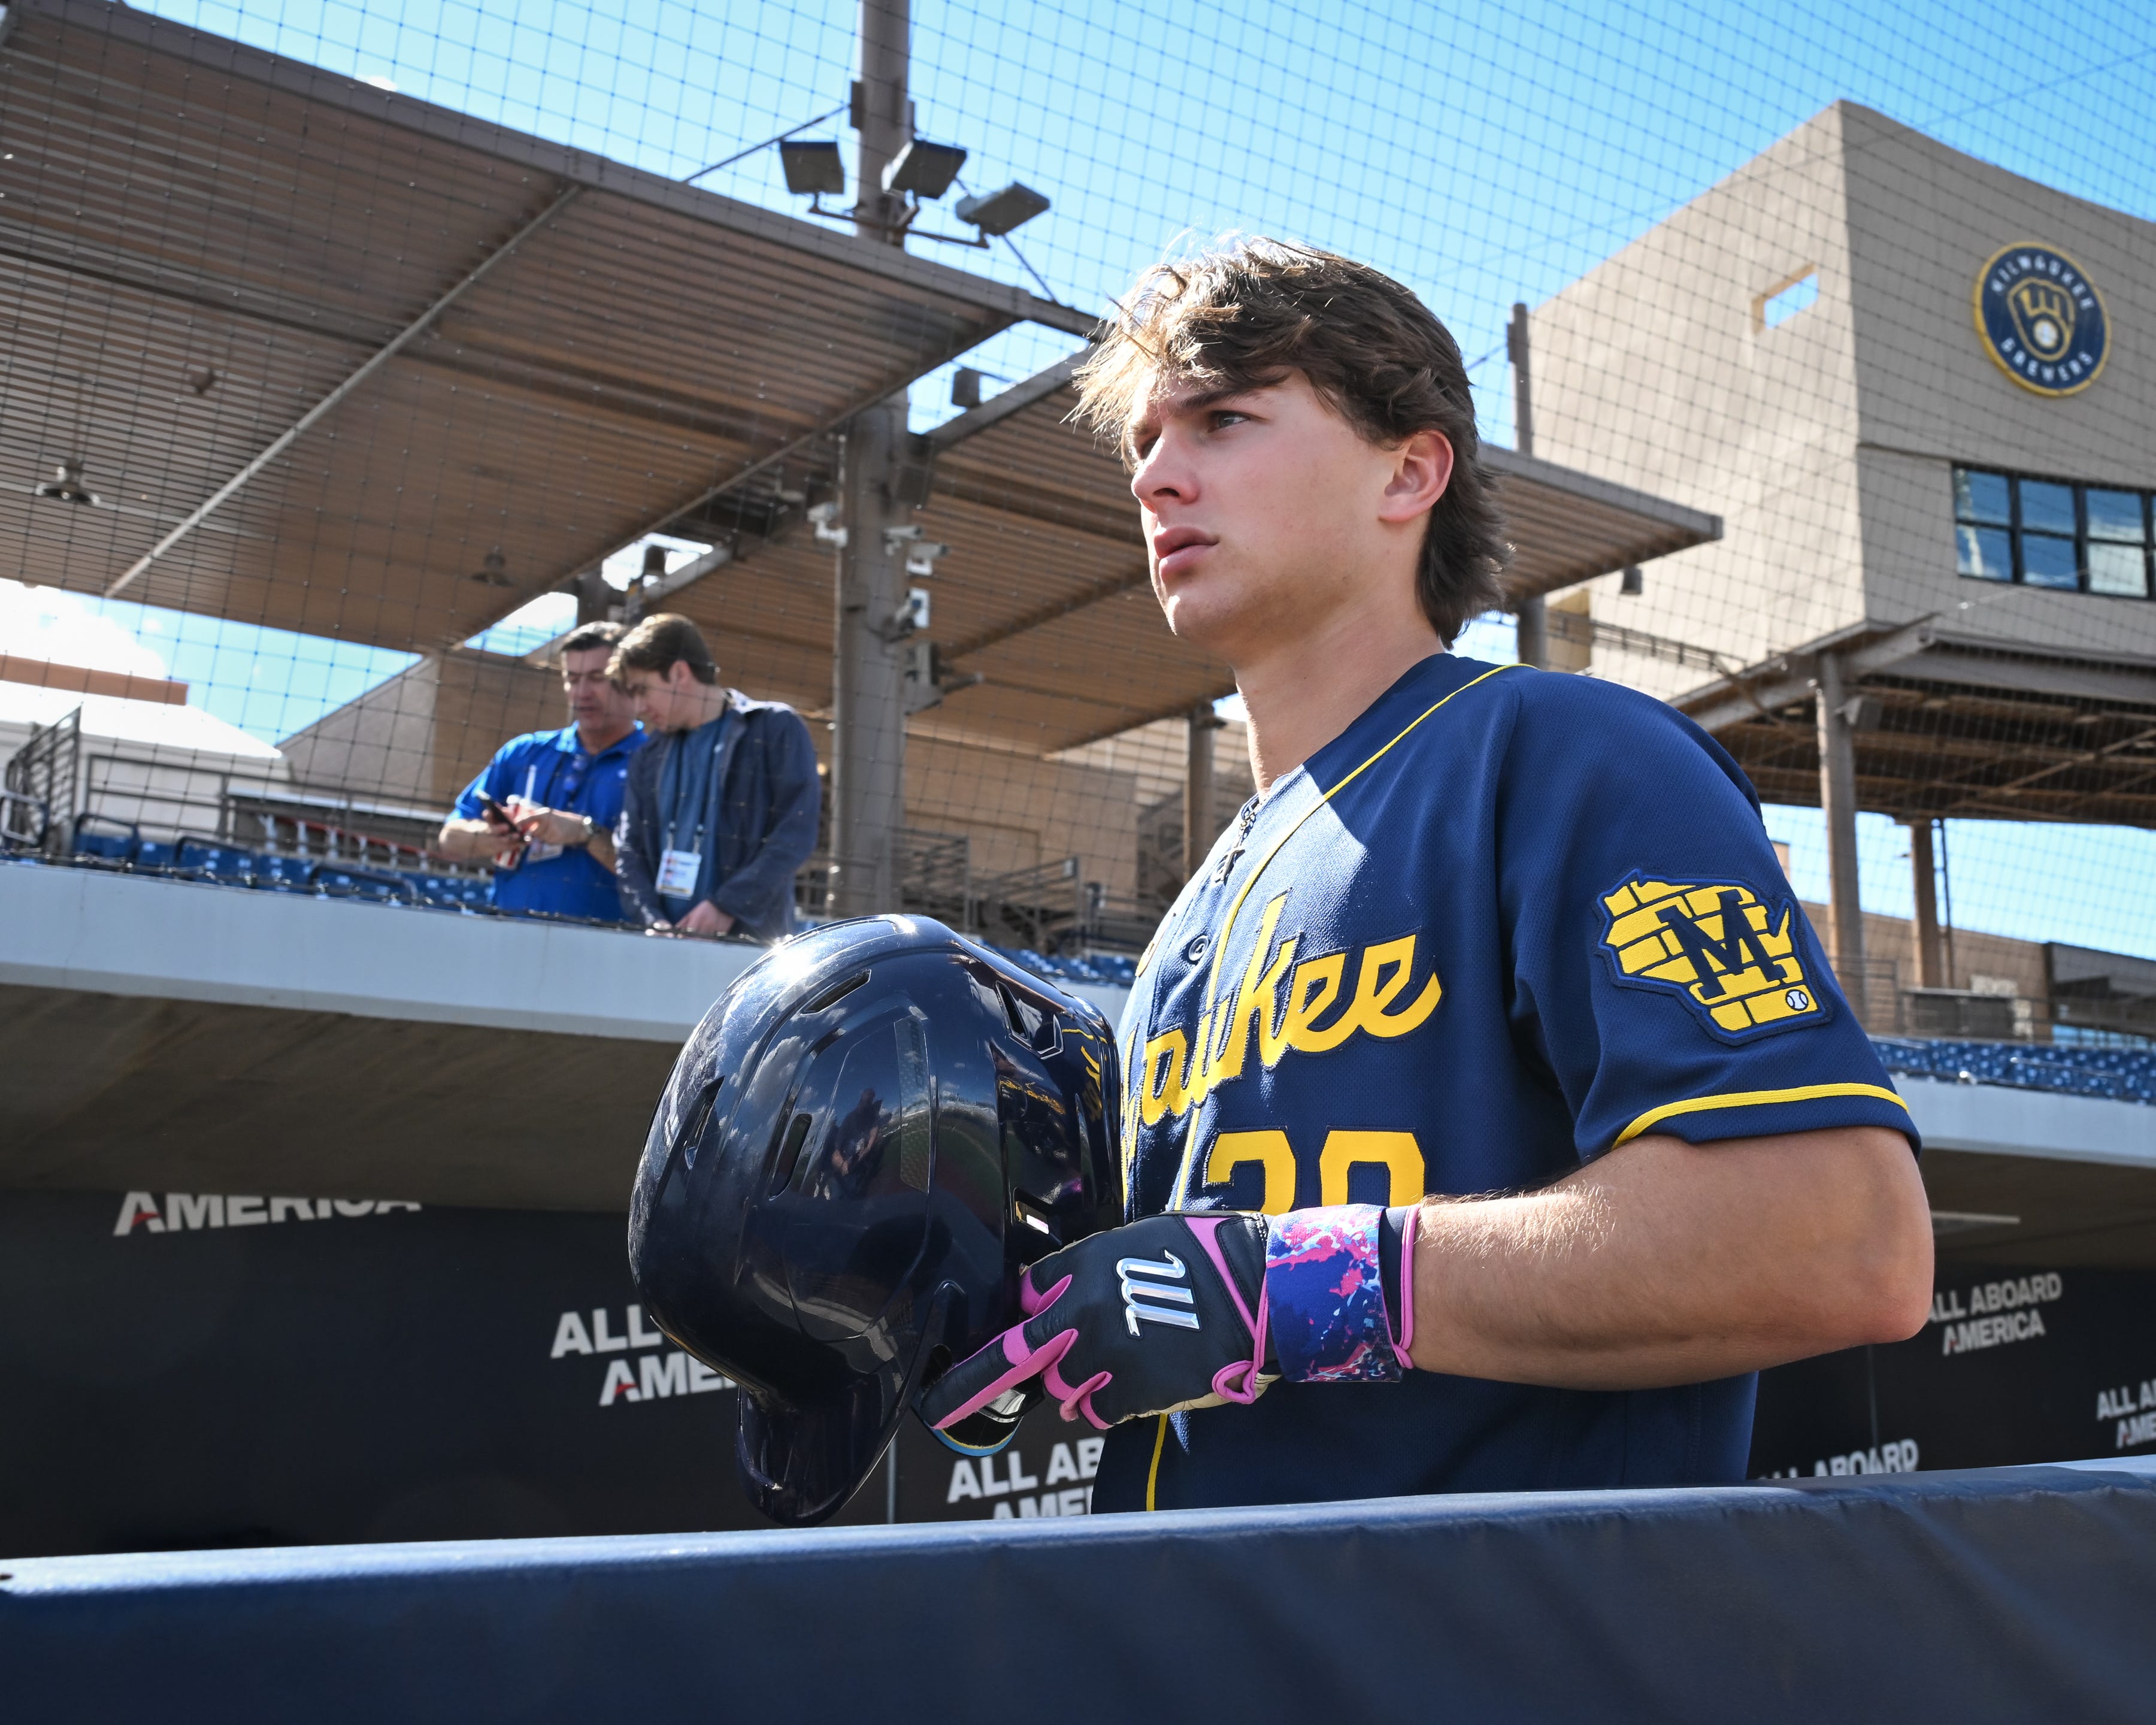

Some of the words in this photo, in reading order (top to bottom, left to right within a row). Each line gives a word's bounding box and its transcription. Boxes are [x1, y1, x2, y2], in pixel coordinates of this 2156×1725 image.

[1121, 890, 1443, 1141] aukee
[113, 1191, 422, 1236] AMER
[1970, 1272, 2062, 1315] ABOARD
[550, 1304, 662, 1358] ALL
[1943, 1308, 2045, 1357] AMERICA
[599, 1351, 738, 1406] AME
[2097, 1385, 2137, 1421] ALL
[947, 1450, 1038, 1503] ALL
